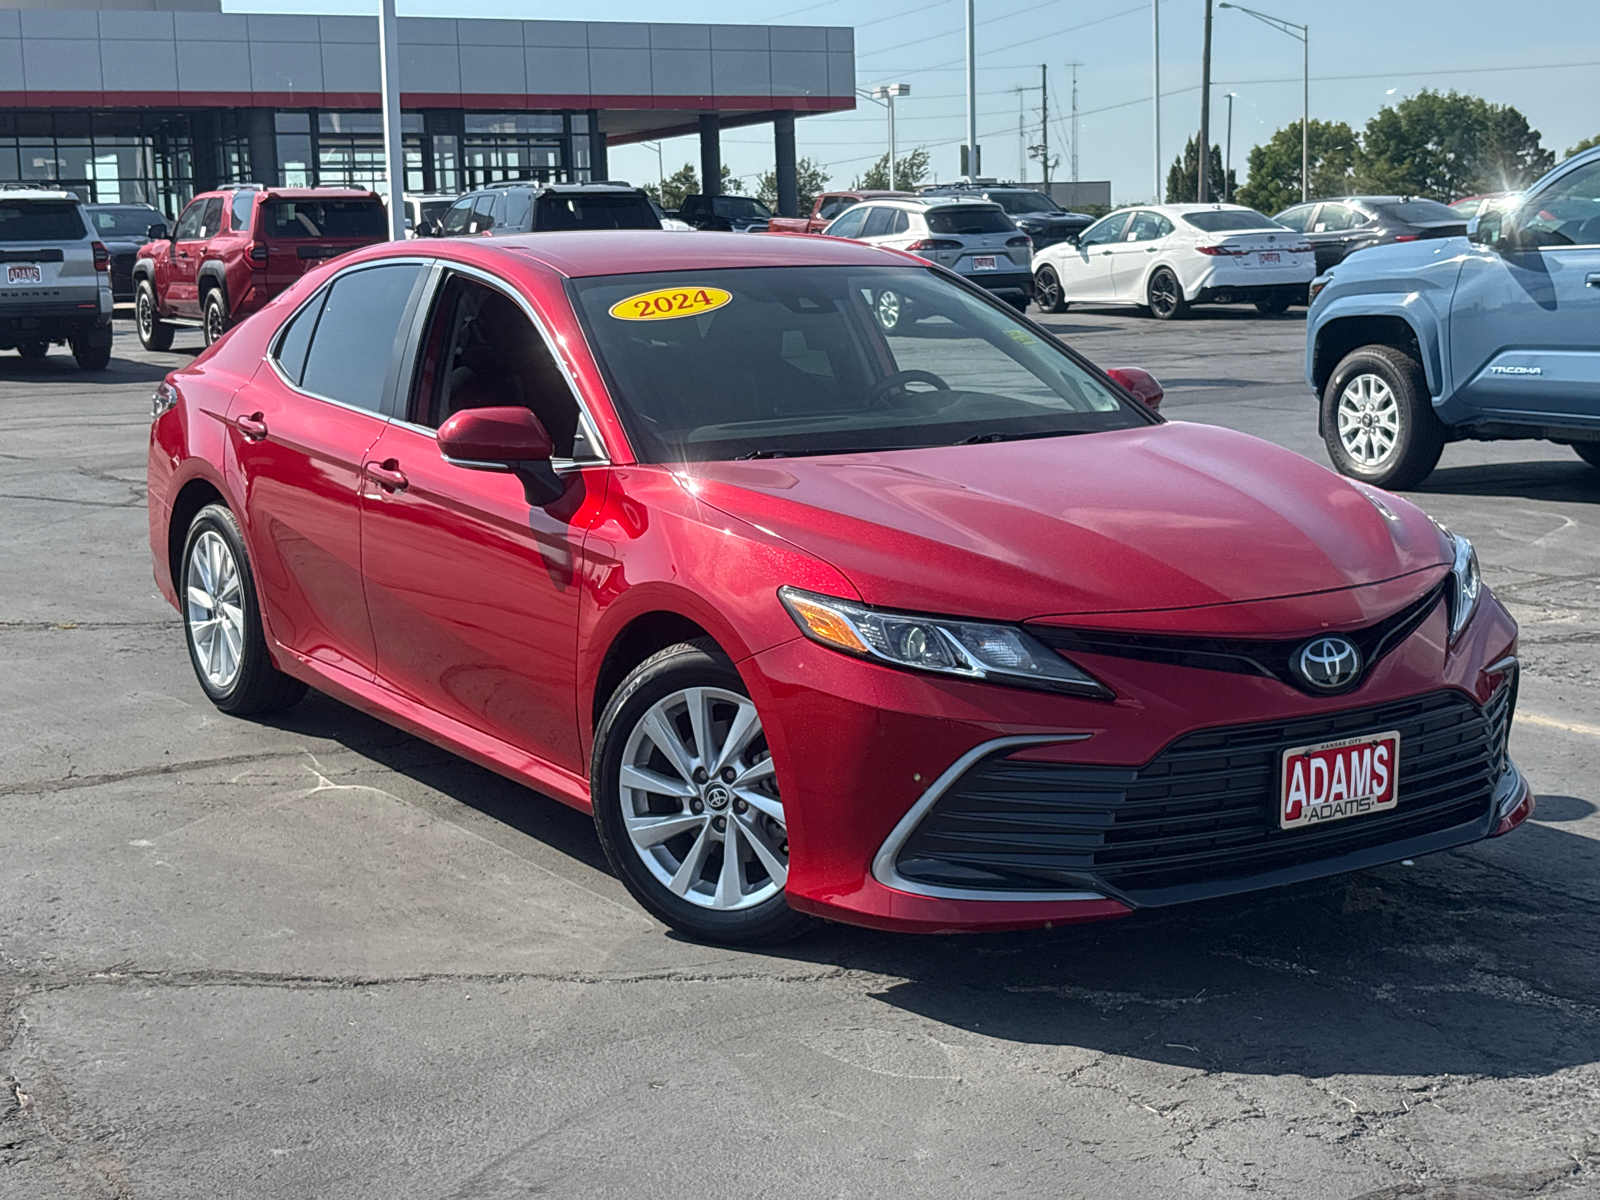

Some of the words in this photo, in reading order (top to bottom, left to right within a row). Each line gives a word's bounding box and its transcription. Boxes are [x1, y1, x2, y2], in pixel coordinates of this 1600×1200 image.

[10, 268, 39, 280] ADAMS
[633, 289, 714, 317] 2024
[1489, 366, 1541, 374] TACOMA
[1320, 740, 1347, 749] KANSAS
[1347, 738, 1362, 746] CITY
[1285, 745, 1388, 814] ADAMS
[1308, 797, 1370, 822] ADAMS
